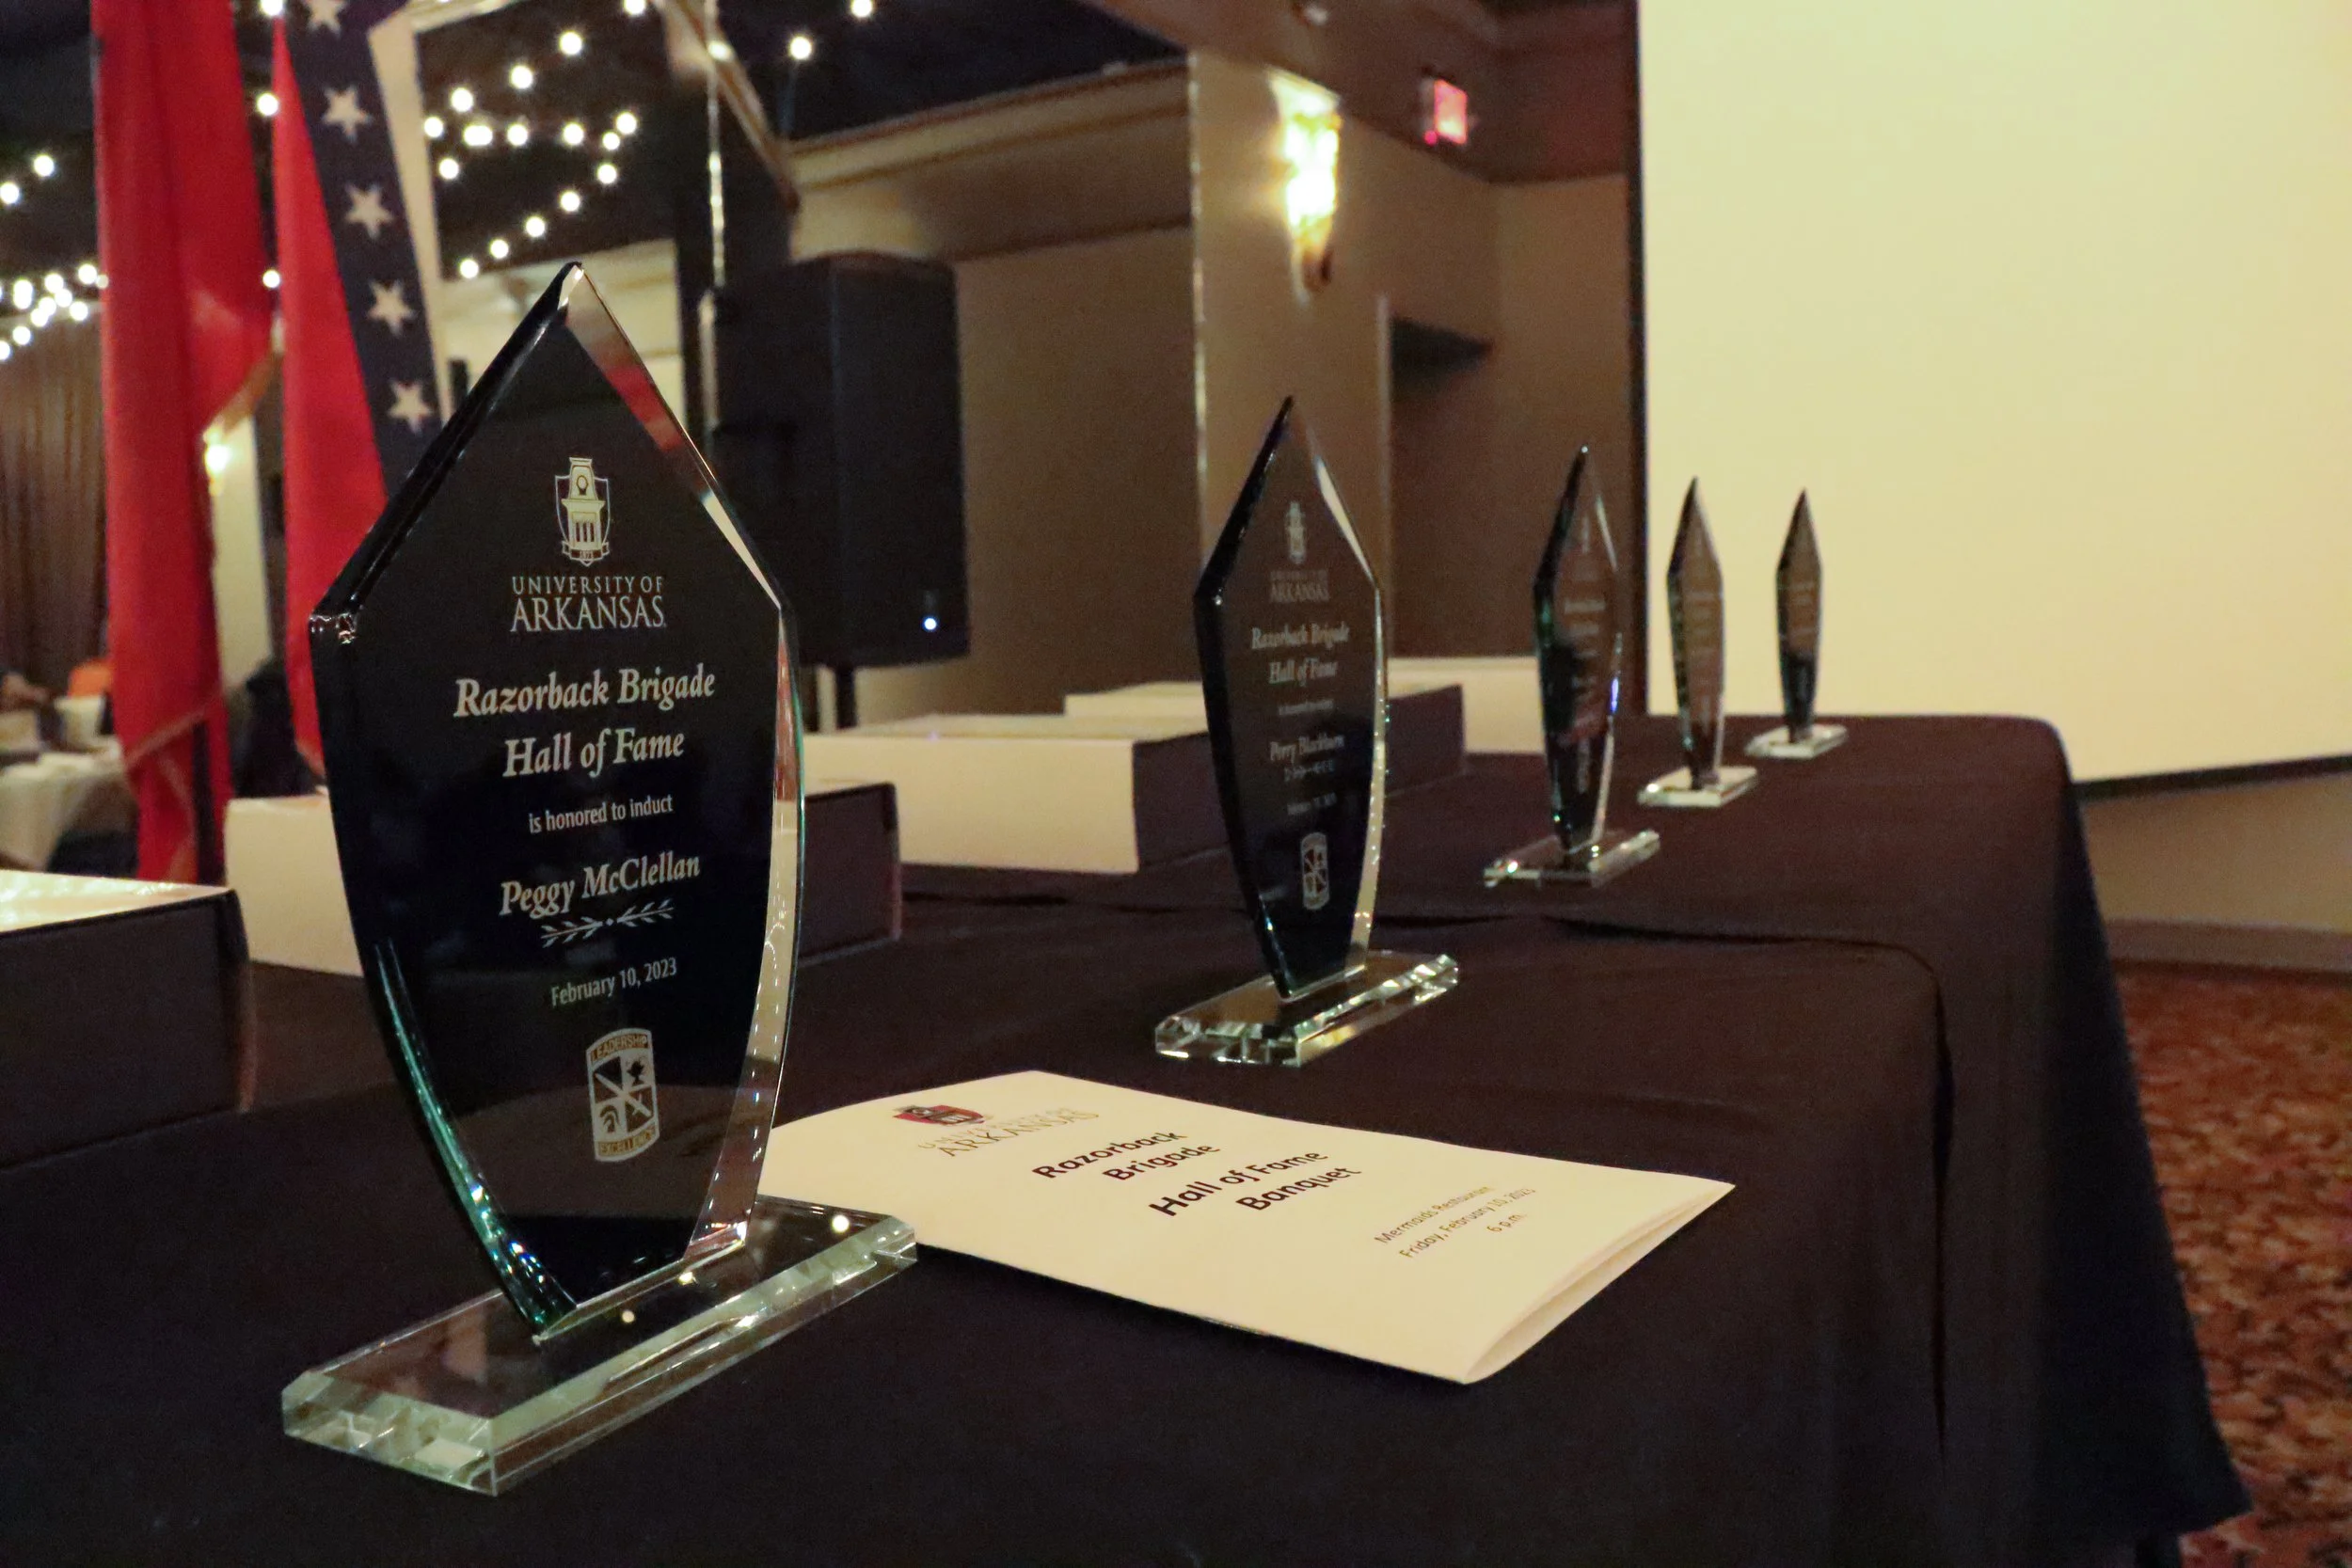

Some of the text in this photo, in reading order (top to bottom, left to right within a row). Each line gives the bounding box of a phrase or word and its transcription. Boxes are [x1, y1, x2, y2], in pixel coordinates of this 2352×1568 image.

[512, 576, 663, 594] UNIVERSITY OF
[510, 595, 664, 632] ARKANSAS
[453, 663, 715, 718] Razorback Brigade
[502, 727, 684, 777] Hall of Fame
[529, 795, 673, 834] is honored to induct
[500, 850, 701, 919] Peggy McClellan
[551, 958, 677, 1007] February 10, 2023
[592, 1035, 647, 1061] LEADERSHIP
[938, 1109, 1099, 1157] ARKANSAS
[1032, 1130, 1188, 1179] Razorback
[1102, 1142, 1221, 1180] Brigade
[1149, 1149, 1329, 1217] Hall of Fame
[1235, 1165, 1362, 1212] Banquet
[1399, 1233, 1450, 1259] Friday,
[1439, 1205, 1496, 1233] February
